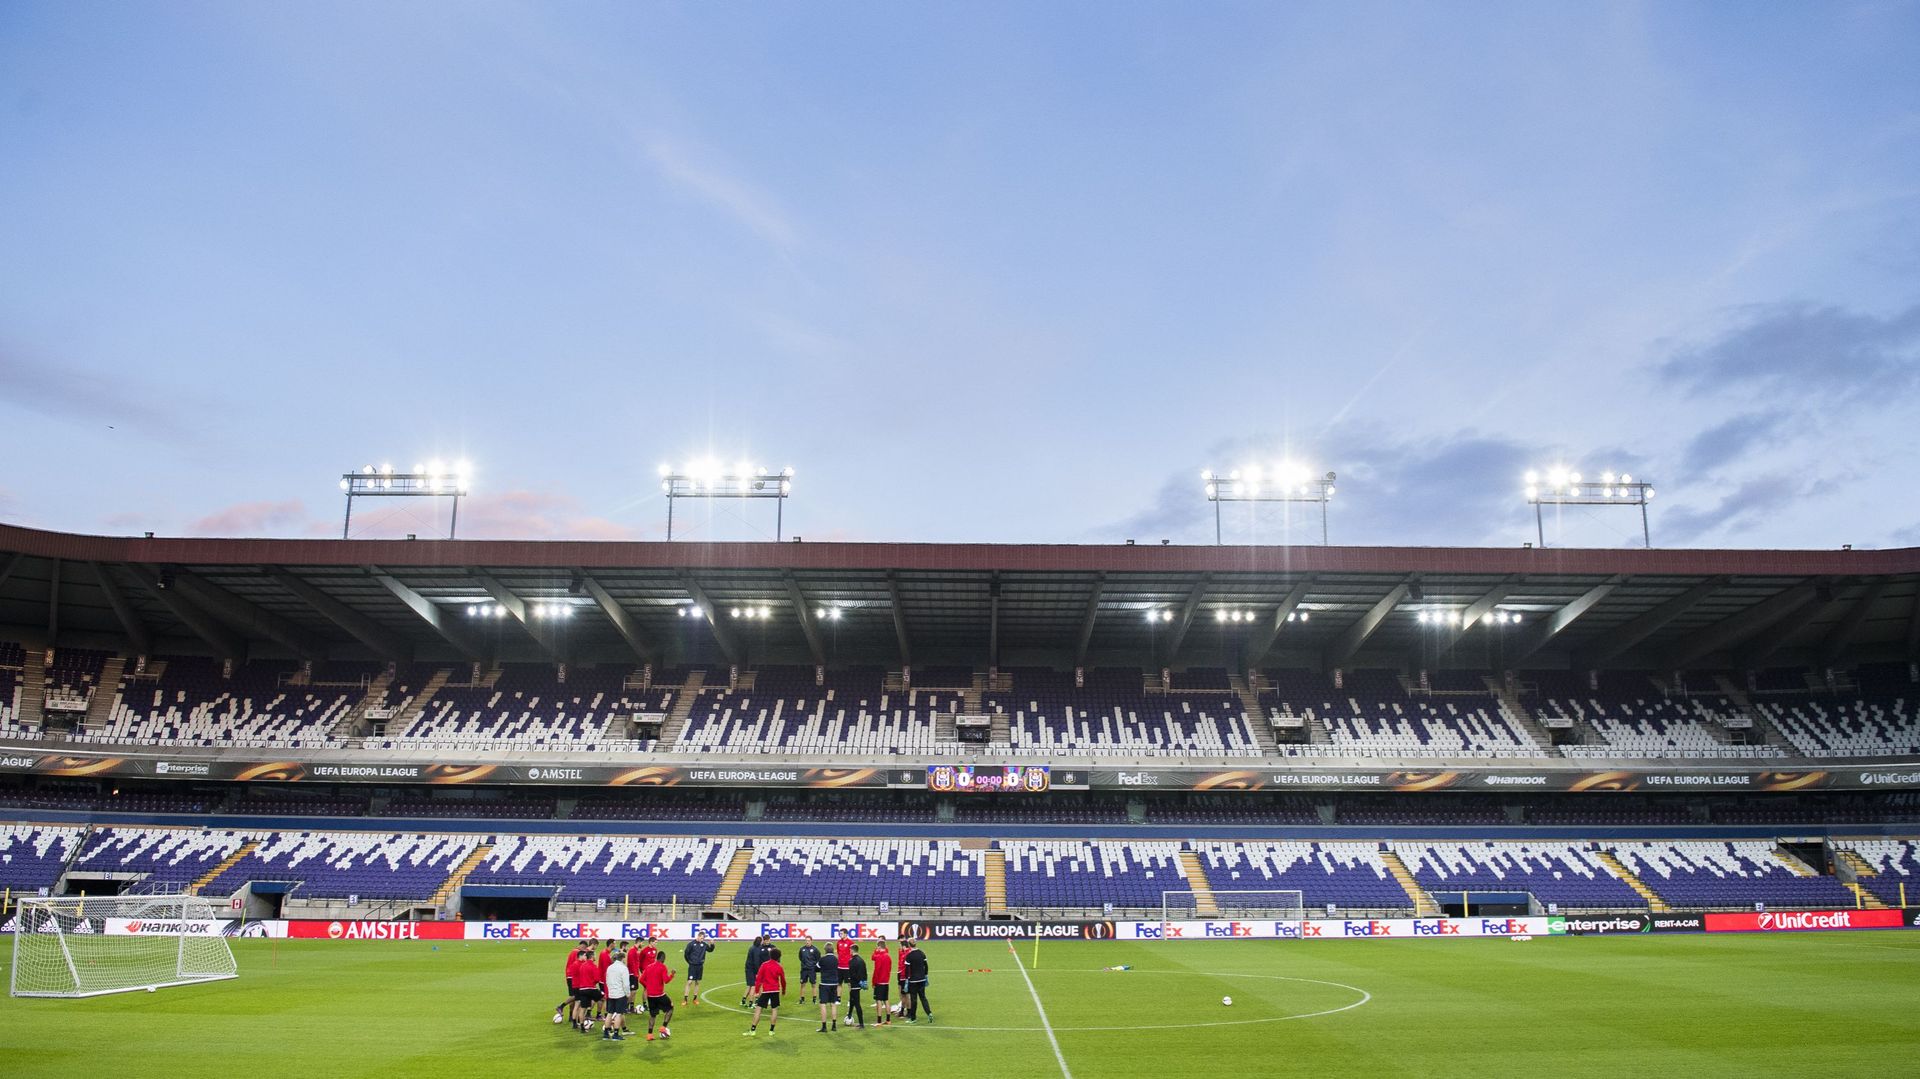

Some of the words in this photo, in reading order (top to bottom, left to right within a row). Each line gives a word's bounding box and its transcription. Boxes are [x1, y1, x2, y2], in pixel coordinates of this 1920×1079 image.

[0, 757, 33, 767] AGUE
[313, 767, 339, 776] UEFA
[341, 767, 378, 777] EUROPA
[380, 767, 418, 777] LEAGUE
[541, 769, 582, 779] AMSTEL
[690, 771, 716, 780] UEFA
[718, 771, 756, 780] EUROPA
[758, 771, 797, 781] LEAGUE
[976, 775, 1002, 784] 00:00
[1118, 772, 1158, 785] FedEx
[1873, 773, 1920, 784] UniCredi
[1273, 775, 1300, 784] UEFA
[1301, 775, 1339, 784] EUROPA
[1341, 775, 1380, 785] LEAGUE
[1646, 776, 1673, 785] UEFA
[1674, 776, 1711, 785] EUROPA
[1713, 776, 1750, 785] LEAGUE
[1413, 920, 1459, 935] FedEx
[1482, 919, 1528, 934] FedEx
[1552, 917, 1641, 933] enterprise
[1654, 919, 1699, 928] RENT-A-CAR
[1775, 912, 1850, 929] UniCredit
[346, 921, 419, 939] AMSTEL
[483, 923, 530, 938] FedEx
[552, 923, 599, 938] FedEx
[622, 923, 669, 938] FedEx
[761, 923, 808, 938] FedEx
[935, 925, 970, 937] UEFA
[973, 925, 1025, 937] EUROPA
[1027, 925, 1079, 937] LEAGUE
[1135, 923, 1183, 938] FedEx
[1205, 922, 1252, 937] FedEx
[1275, 922, 1322, 937] FedEx
[1344, 921, 1391, 936] FedEx
